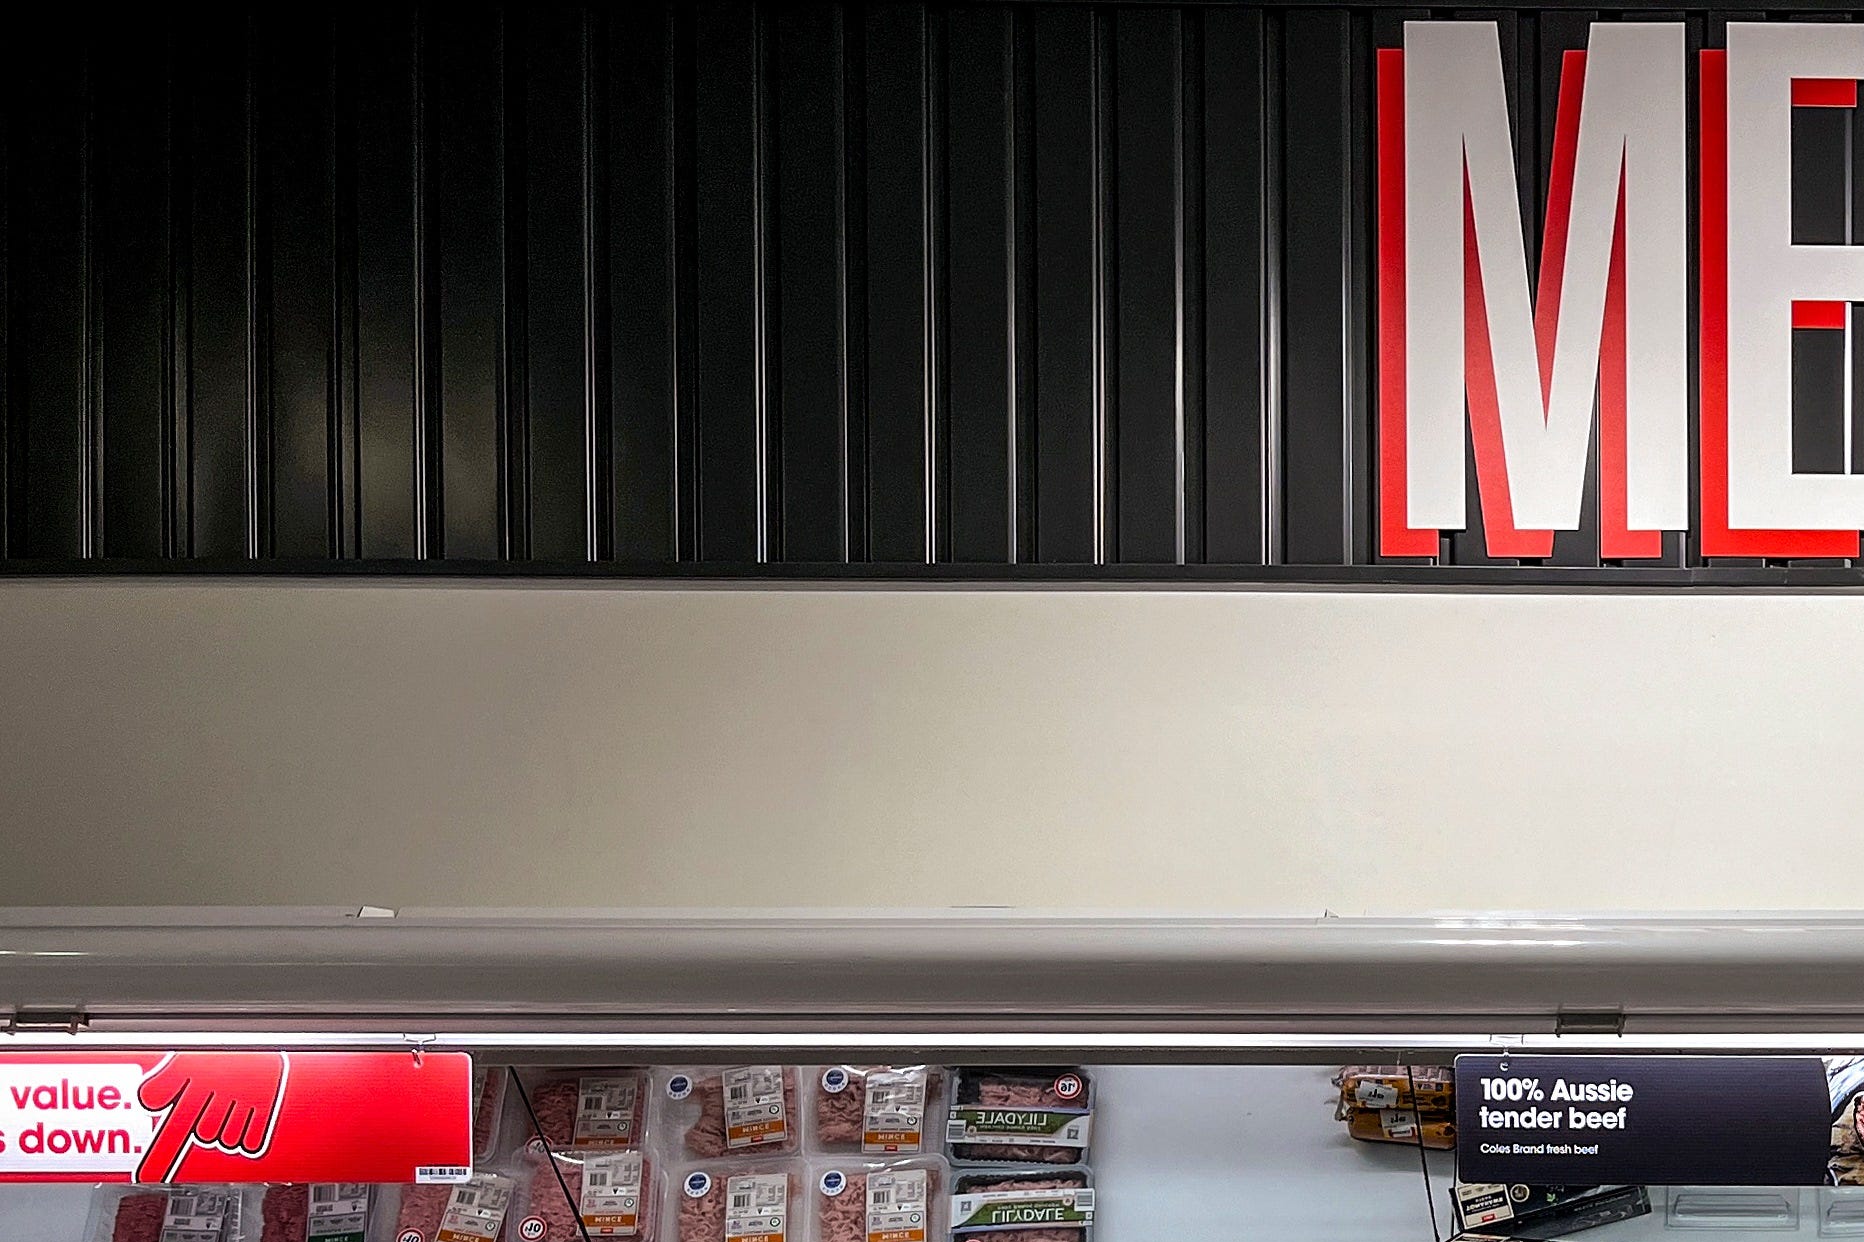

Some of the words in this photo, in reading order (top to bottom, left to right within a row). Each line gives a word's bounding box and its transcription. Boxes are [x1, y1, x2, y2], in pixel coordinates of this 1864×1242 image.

[9, 1078, 132, 1110] value.
[1480, 1078, 1545, 1101] 100%
[1550, 1078, 1634, 1102] Aussie
[1479, 1106, 1563, 1129] tender
[1568, 1106, 1627, 1129] beef
[18, 1121, 142, 1154] down.
[1480, 1143, 1511, 1155] Coles
[1512, 1143, 1545, 1155] Brand
[1546, 1143, 1572, 1155] fresh
[1574, 1144, 1599, 1155] beef
